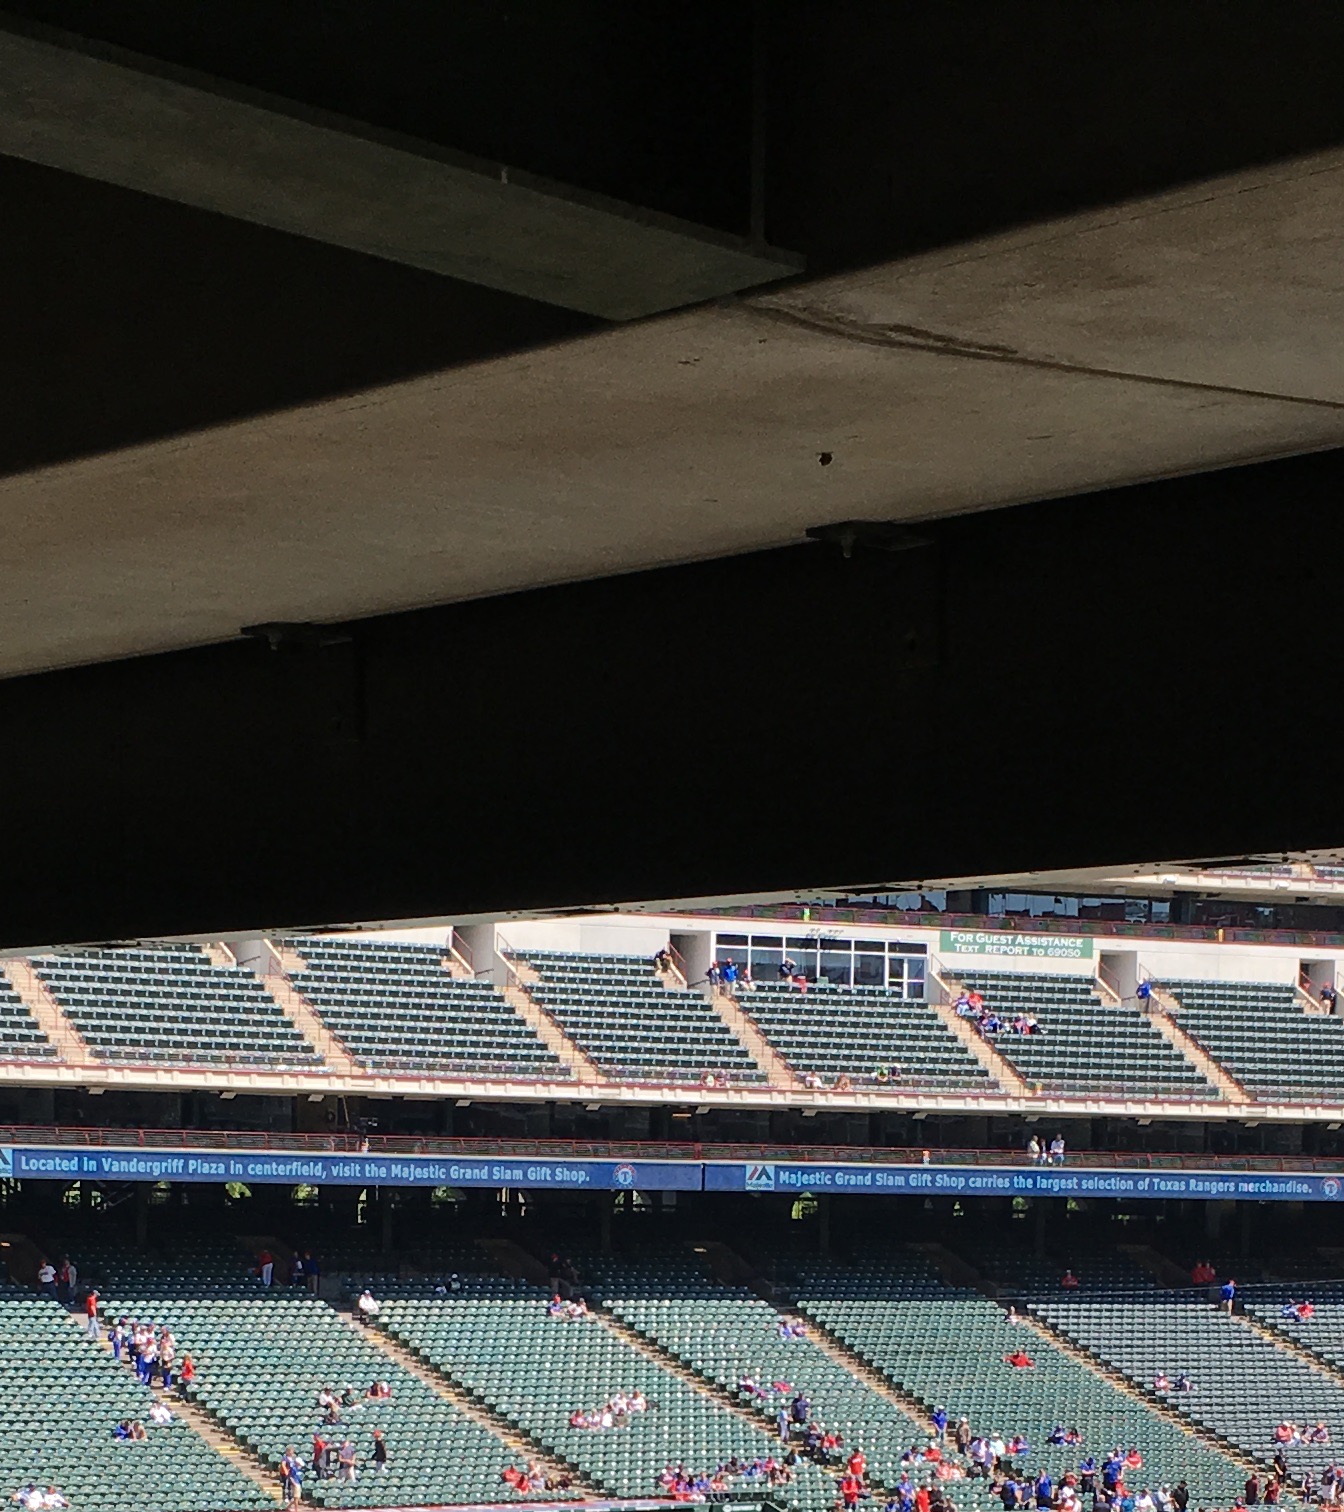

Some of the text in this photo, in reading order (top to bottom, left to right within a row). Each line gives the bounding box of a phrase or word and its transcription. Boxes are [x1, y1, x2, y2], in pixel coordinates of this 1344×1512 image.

[950, 932, 1083, 948] FOR GUEST ASSISTANCE
[954, 944, 979, 954] TEXT
[985, 945, 1029, 956] REPORT
[21, 1156, 590, 1185] Located in Vandergriff Plaza in centerfield, visit the Majestic Grand Slam Gift Shop.
[779, 1171, 1313, 1194] Majestic Grand Slam Gift Shop carries the largest selection of Texas Rangers merchandise.
